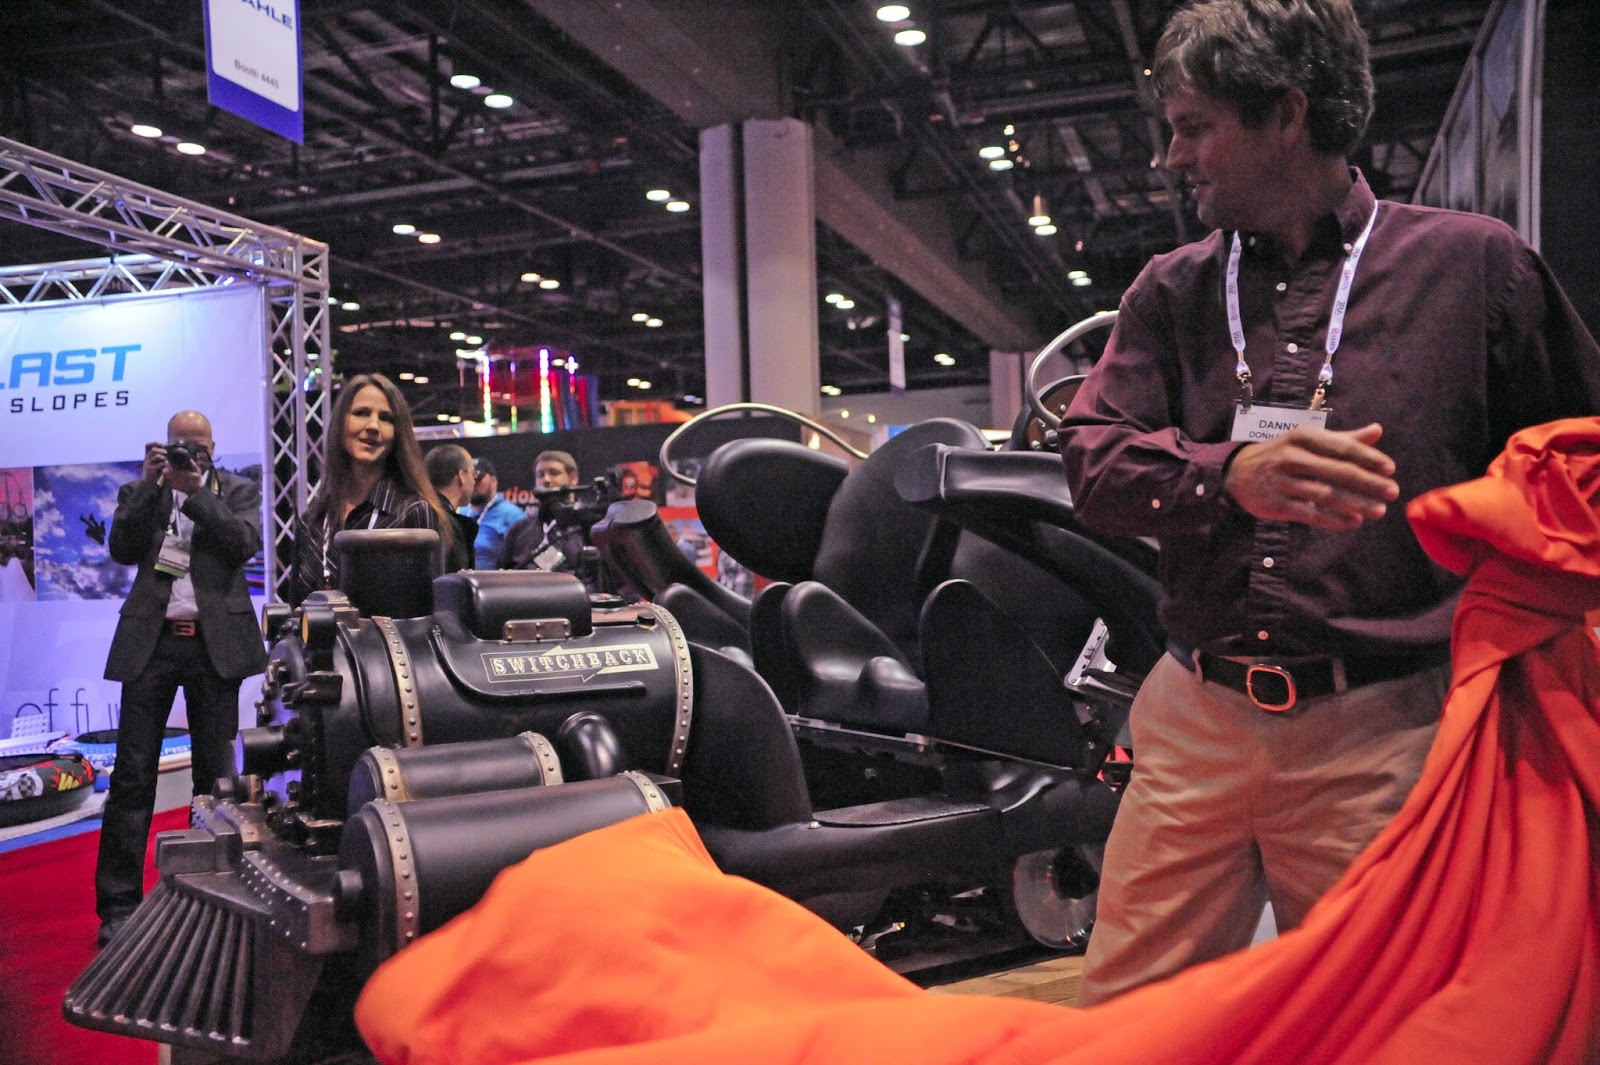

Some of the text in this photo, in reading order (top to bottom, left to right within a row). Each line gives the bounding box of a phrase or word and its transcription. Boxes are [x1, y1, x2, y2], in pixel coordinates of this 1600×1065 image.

[0, 344, 141, 389] AST
[10, 390, 129, 413] SLOPES
[1249, 430, 1280, 440] DONH
[1259, 419, 1299, 431] DANNY
[493, 649, 649, 674] SWITCHBACK
